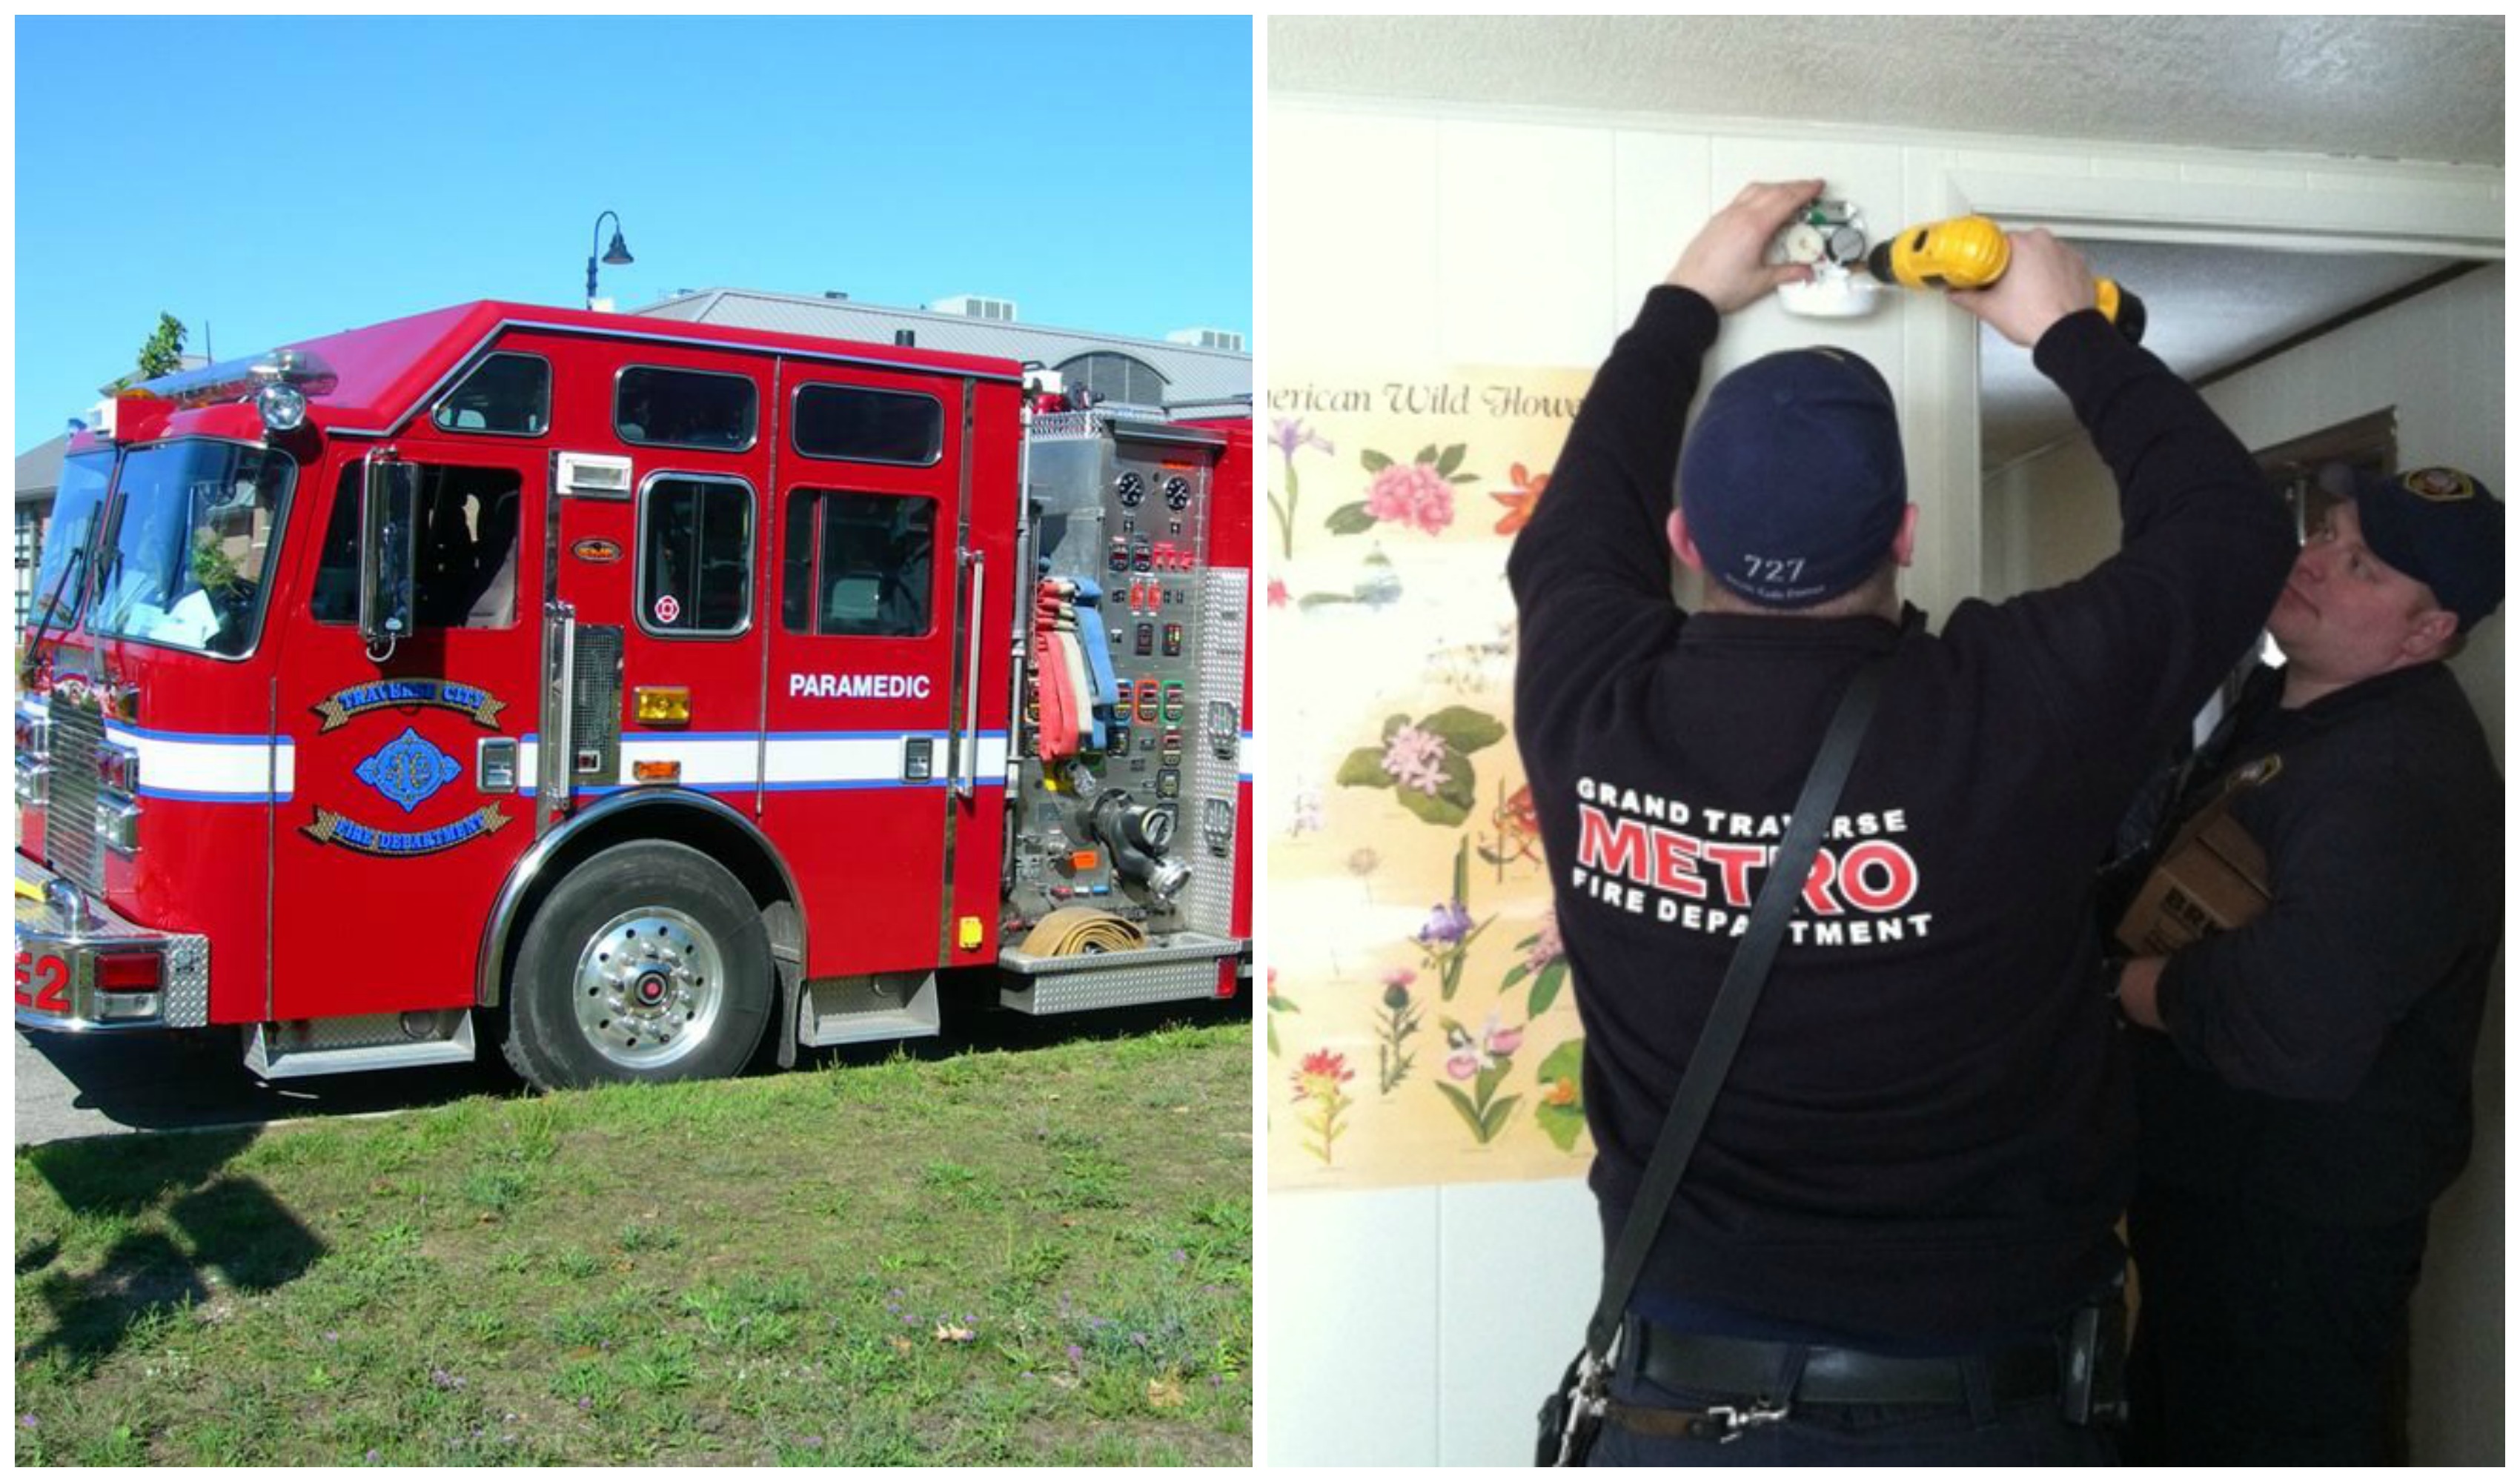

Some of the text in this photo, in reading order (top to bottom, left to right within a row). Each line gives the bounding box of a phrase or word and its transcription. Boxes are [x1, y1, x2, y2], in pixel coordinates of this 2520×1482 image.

[1383, 383, 1469, 415] Wild
[1481, 385, 1582, 418] Flow
[1744, 554, 1806, 582] 727
[339, 683, 485, 709] TRAVER CITY
[789, 672, 931, 699] PARAMEDIC
[1576, 777, 1907, 839] GRAND TRARSE
[336, 811, 485, 850] FIRE DEPARTMENT
[1571, 866, 1932, 946] FIRE DEPATMENT
